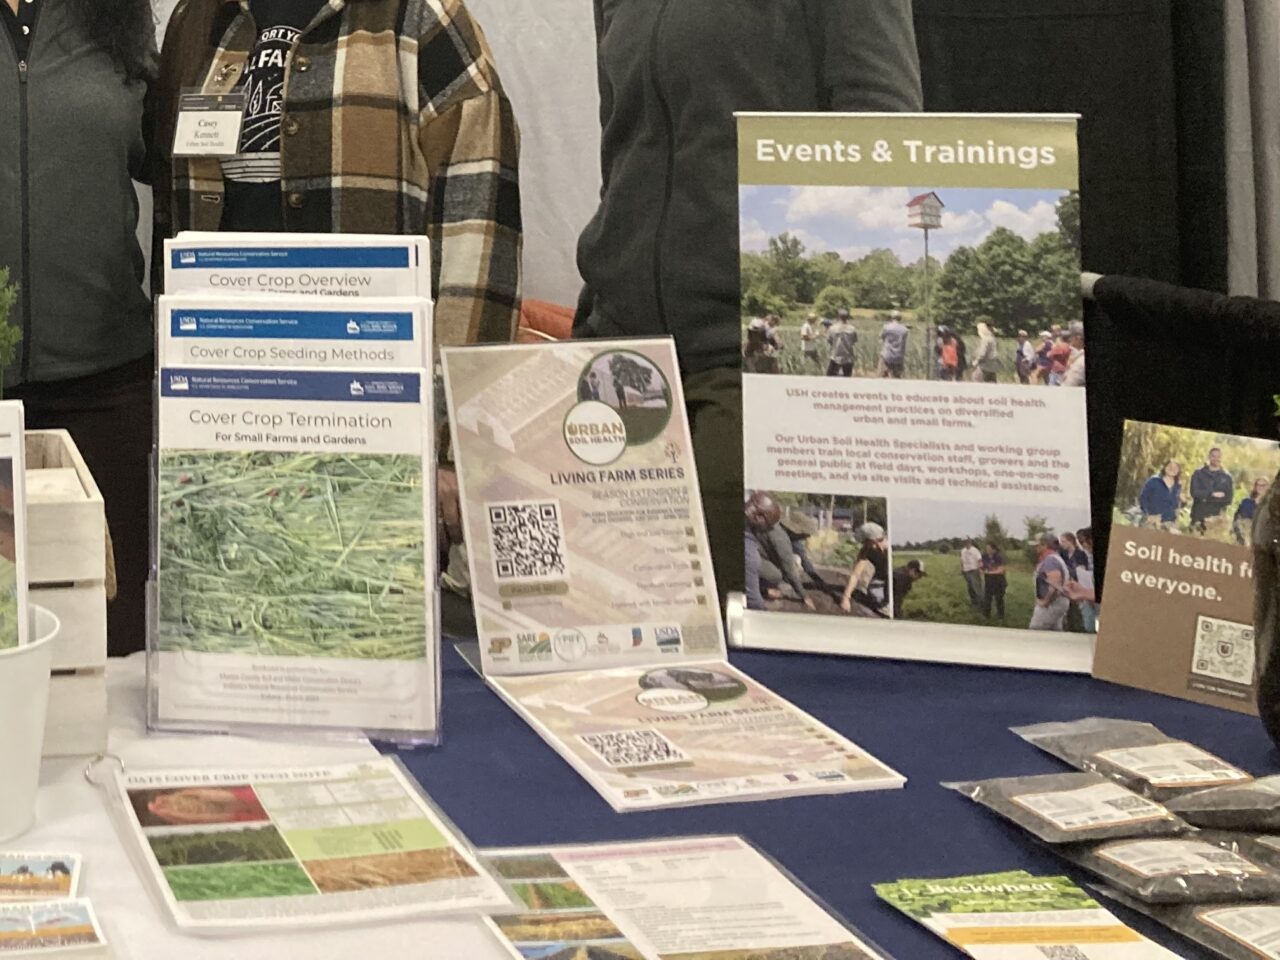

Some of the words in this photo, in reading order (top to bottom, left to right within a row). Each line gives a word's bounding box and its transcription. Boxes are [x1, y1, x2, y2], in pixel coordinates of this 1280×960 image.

[756, 139, 861, 163] Events
[871, 140, 893, 163] &
[904, 140, 1057, 169] Trainings
[209, 273, 252, 288] Cover
[257, 273, 295, 290] Crop
[299, 273, 372, 288] Overview
[319, 289, 360, 297] Gardens
[190, 346, 228, 359] Cover
[233, 346, 266, 361] Crop
[270, 346, 327, 361] Seeding
[332, 348, 395, 361] Methods
[170, 375, 188, 384] USDA
[786, 389, 809, 398] USH
[811, 390, 850, 400] creates
[853, 392, 888, 401] events
[891, 393, 902, 402] to
[906, 393, 950, 403] educate
[953, 395, 985, 405] about
[988, 396, 1008, 406] soil
[1010, 397, 1046, 408] health
[813, 402, 883, 413] management
[885, 404, 935, 416] practices
[938, 407, 952, 416] on
[955, 407, 1014, 418] diversified
[189, 410, 237, 425] Cover
[242, 411, 283, 428] Crop
[288, 412, 393, 429] Termination
[853, 415, 884, 425] urban
[887, 416, 907, 426] and
[910, 417, 939, 427] small
[942, 418, 976, 429] farms.
[568, 421, 624, 436] URBAN
[215, 432, 231, 442] For
[234, 433, 263, 443] Small
[266, 433, 298, 444] Farms
[301, 434, 320, 444] and
[323, 435, 367, 446] Gardens
[569, 436, 589, 444] SOIL
[591, 435, 626, 444] HEALTH
[775, 433, 795, 443] Our
[797, 434, 830, 445] Urban
[833, 436, 853, 446] Soil
[855, 437, 890, 448] Health
[893, 439, 951, 452] Specialists
[953, 442, 974, 452] and
[977, 444, 1023, 457] working
[1026, 447, 1061, 458] group
[766, 445, 816, 456] members
[818, 447, 843, 457] train
[845, 448, 870, 459] local
[874, 451, 944, 463] conservation
[978, 456, 1024, 467] growers
[1027, 458, 1048, 469] and
[1051, 459, 1071, 470] the
[550, 471, 596, 485] LIVING
[600, 469, 637, 482] FARM
[640, 467, 686, 480] SERIES
[777, 457, 817, 468] general
[820, 458, 852, 470] public
[855, 461, 866, 470] at
[869, 461, 894, 472] field
[928, 466, 991, 478] workshops,
[993, 470, 1061, 480] one-on-one
[774, 469, 827, 481] meetings,
[829, 470, 849, 481] and
[852, 472, 868, 482] via
[870, 473, 891, 484] site
[893, 475, 921, 486] visits
[924, 477, 945, 487] and
[948, 478, 999, 489] technical
[1001, 481, 1064, 493] assistance.
[1124, 540, 1162, 562] Soil
[1169, 548, 1233, 577] health
[1120, 569, 1222, 602] everyone.
[654, 626, 680, 637] USDA
[690, 711, 730, 720] FARM
[733, 705, 784, 717] SERIES
[128, 775, 163, 785] OATS
[165, 773, 211, 784] COVER
[214, 772, 249, 782] CROP
[927, 880, 1058, 896] Buckwheat
